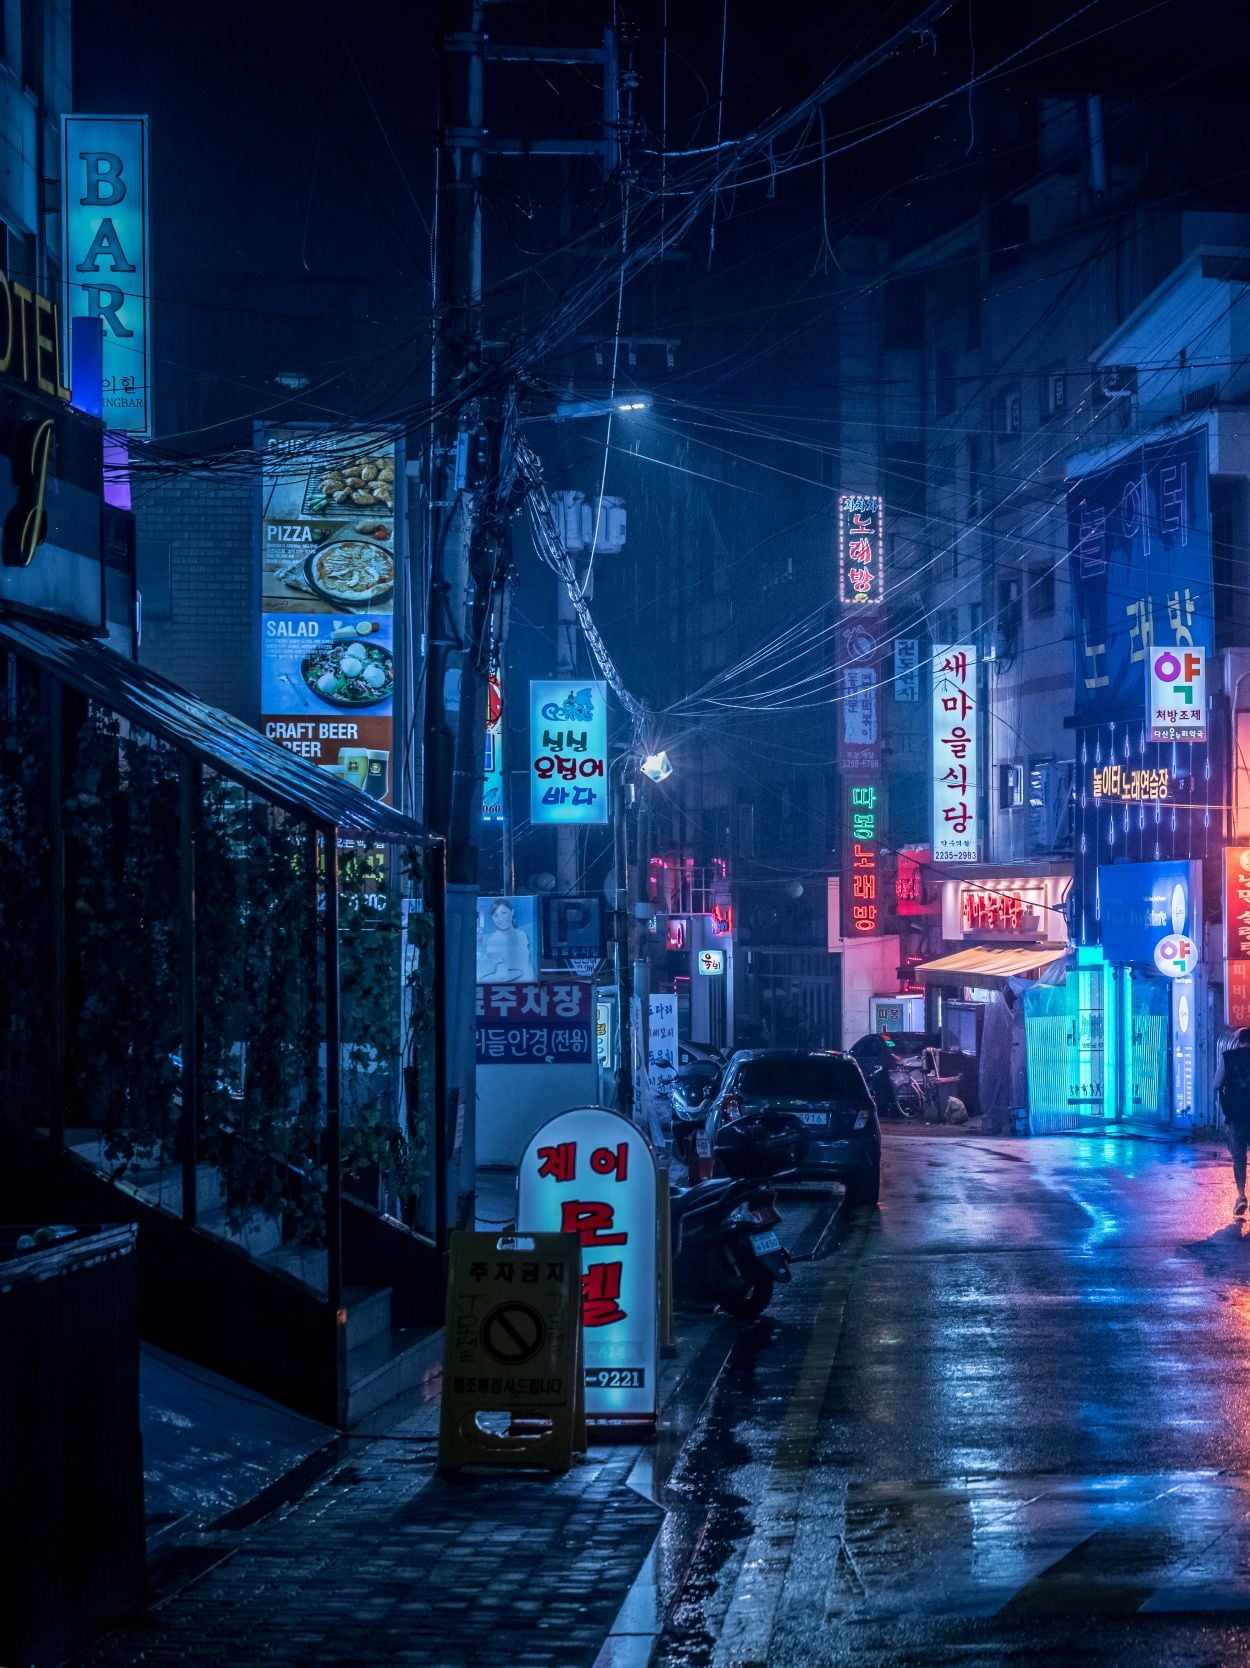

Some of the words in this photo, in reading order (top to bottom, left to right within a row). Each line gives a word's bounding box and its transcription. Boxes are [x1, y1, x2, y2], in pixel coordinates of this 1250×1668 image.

[76, 152, 136, 338] BAR
[267, 526, 312, 541] PIZZA
[849, 513, 876, 592] 노래방
[266, 620, 319, 637] SALAD
[1154, 652, 1200, 704] 약
[266, 722, 315, 739] CRAFT
[319, 723, 358, 739] BEER
[1156, 709, 1201, 722] 처방조제
[940, 651, 974, 834] 새마을식당
[534, 755, 604, 780] 오징어
[1093, 765, 1121, 797] 놀이터
[1122, 768, 1168, 799] 노래연습장
[541, 786, 597, 805] 바다
[935, 850, 977, 861] 2235-2983
[853, 845, 876, 931] 노래방
[1159, 941, 1190, 972] 약
[538, 1141, 629, 1182] 제이
[469, 1262, 564, 1283] 주차금지
[561, 1199, 628, 1328] 모텔
